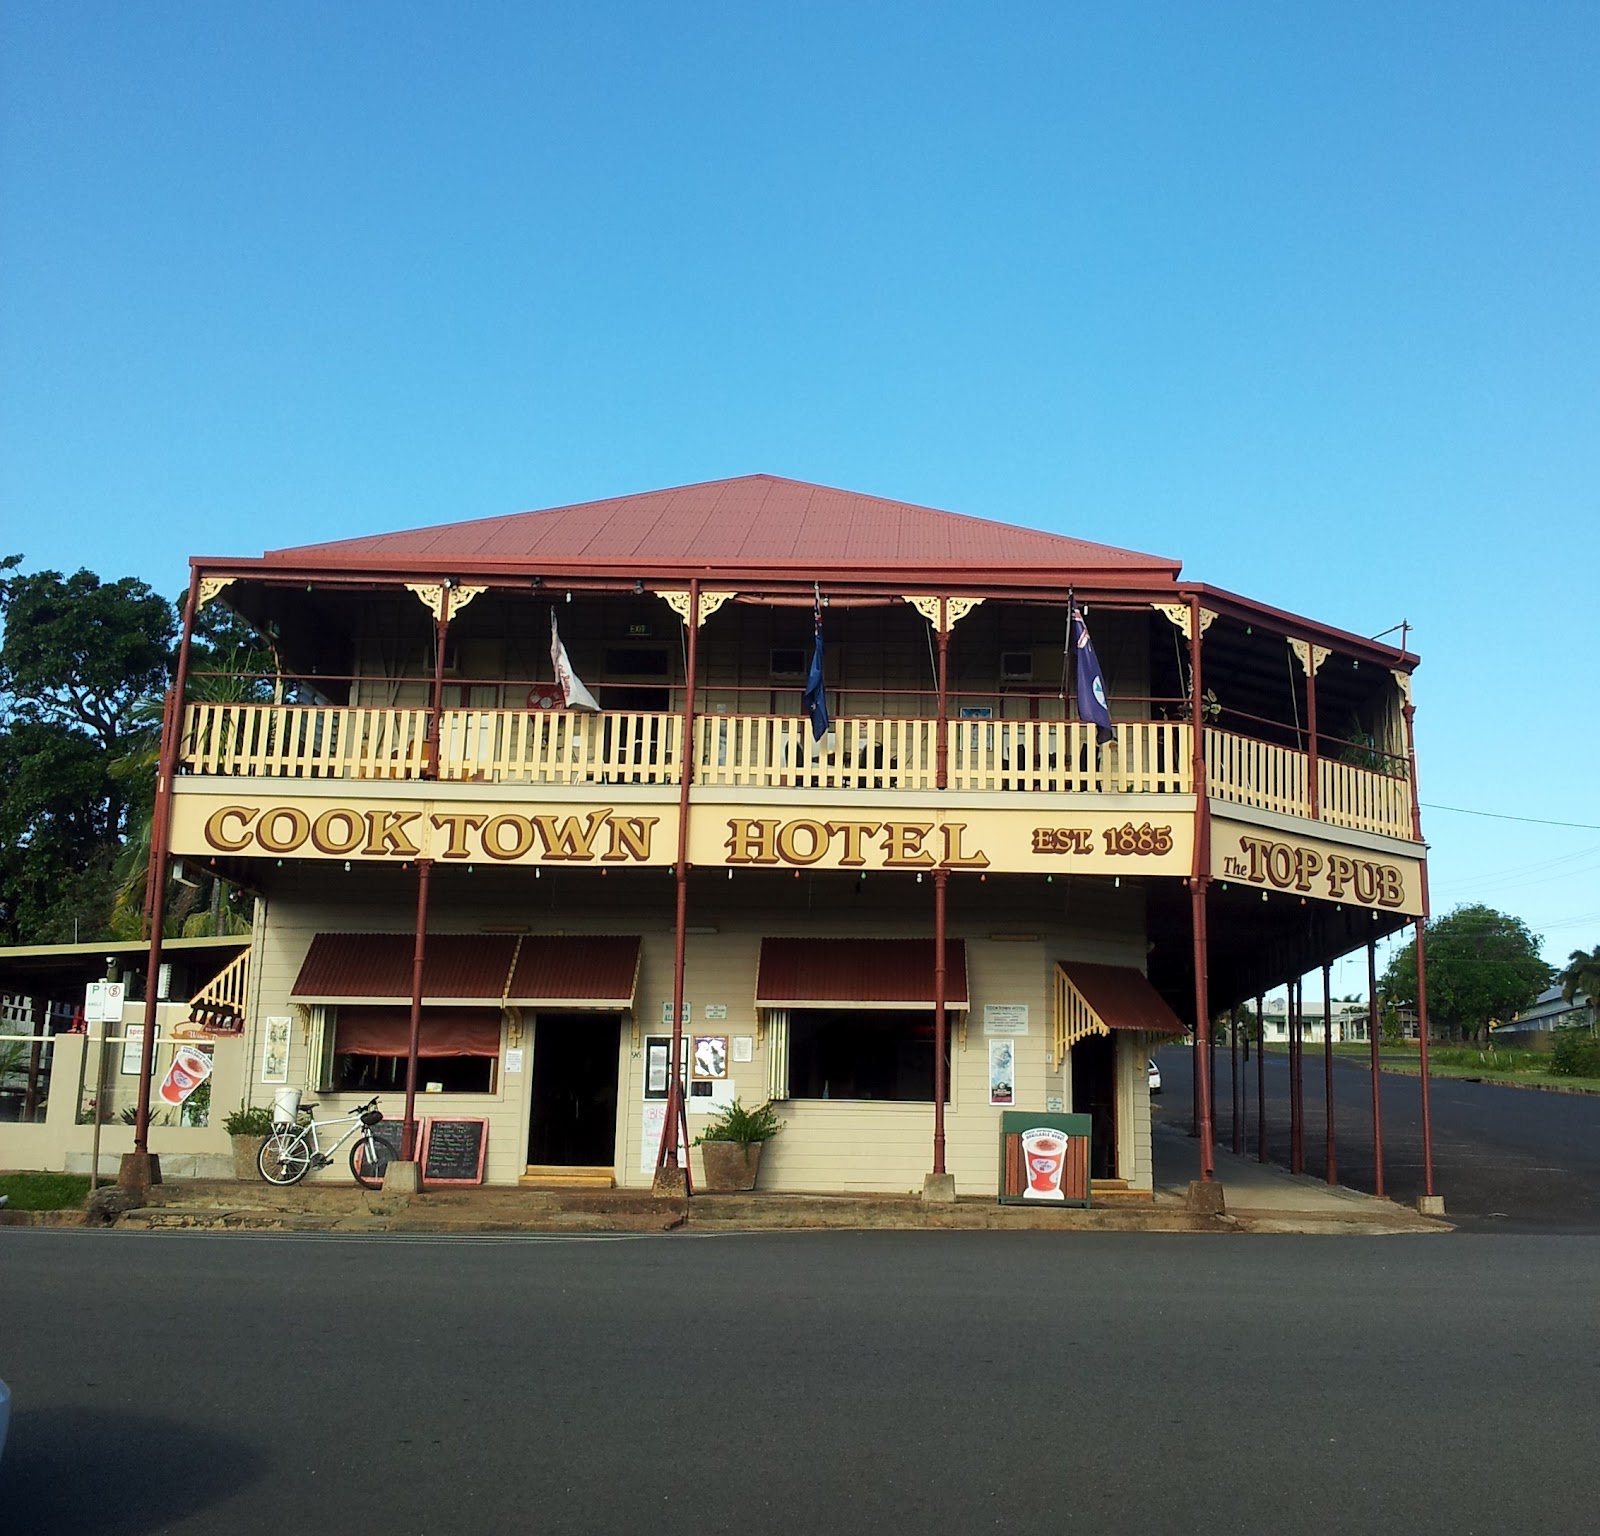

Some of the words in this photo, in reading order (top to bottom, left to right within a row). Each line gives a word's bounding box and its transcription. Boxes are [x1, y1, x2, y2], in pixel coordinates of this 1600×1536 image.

[629, 624, 645, 633] EXIT
[724, 818, 990, 868] HOTEL
[1031, 826, 1094, 856] EST.
[1103, 822, 1174, 857] 1885
[1223, 855, 1248, 878] The
[1240, 836, 1324, 892] TOP
[1327, 854, 1406, 908] PUB
[92, 985, 100, 994] P
[631, 1051, 642, 1059] 96
